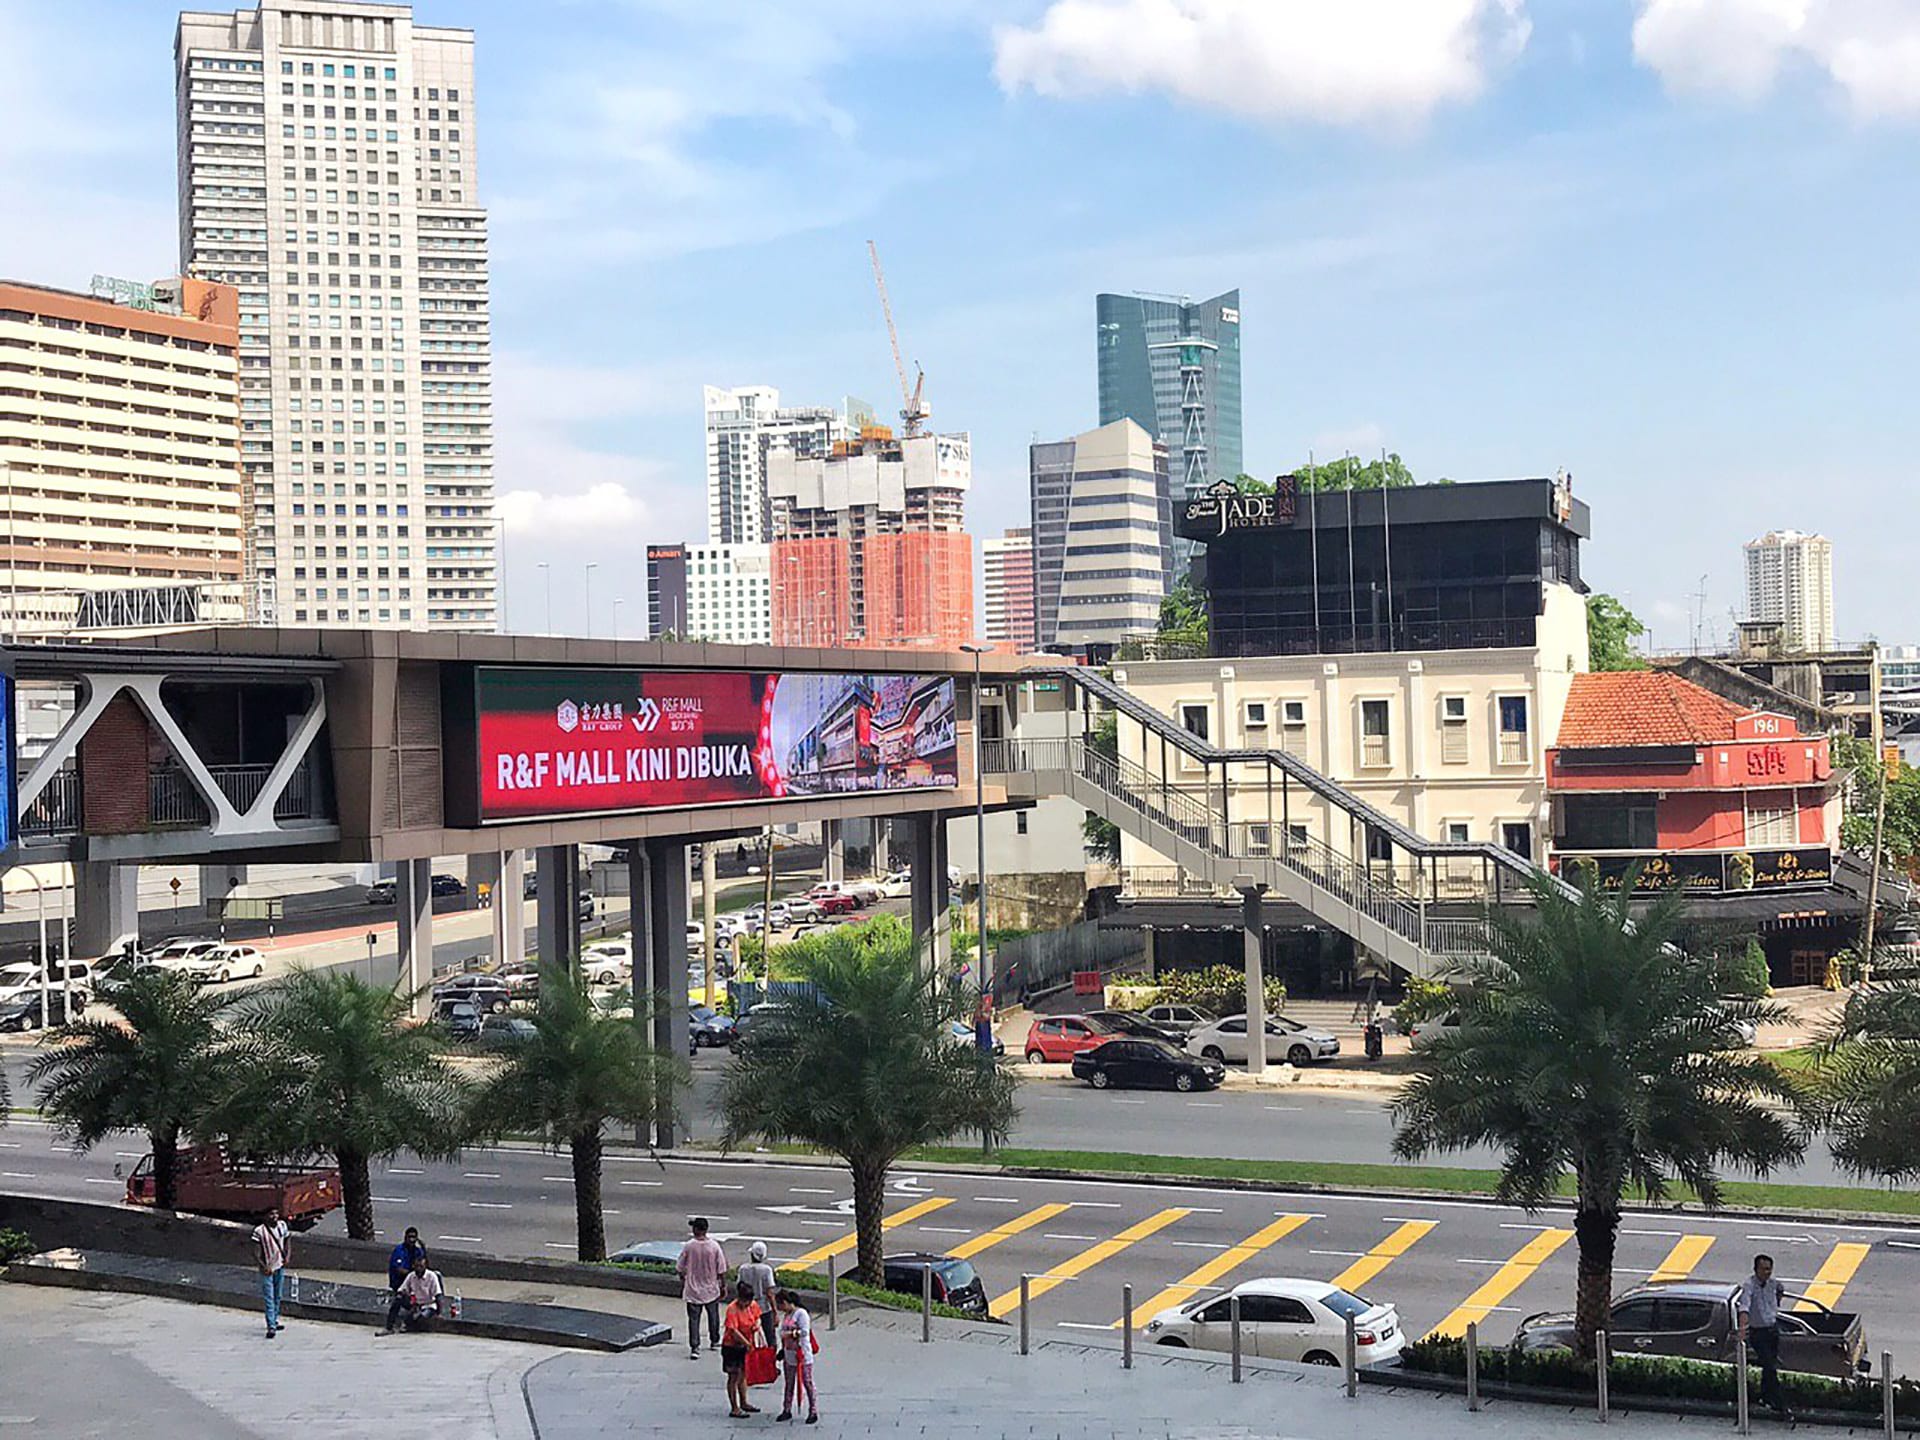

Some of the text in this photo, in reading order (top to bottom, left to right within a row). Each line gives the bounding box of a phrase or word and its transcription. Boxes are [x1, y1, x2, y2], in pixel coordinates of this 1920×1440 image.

[1201, 500, 1216, 509] THE
[1217, 498, 1275, 537] JADE
[1229, 517, 1274, 527] HOTEL
[662, 697, 703, 713] R&F MALL
[1754, 719, 1779, 734] 1961
[497, 745, 752, 790] R&F MALL KINI DIBUKA
